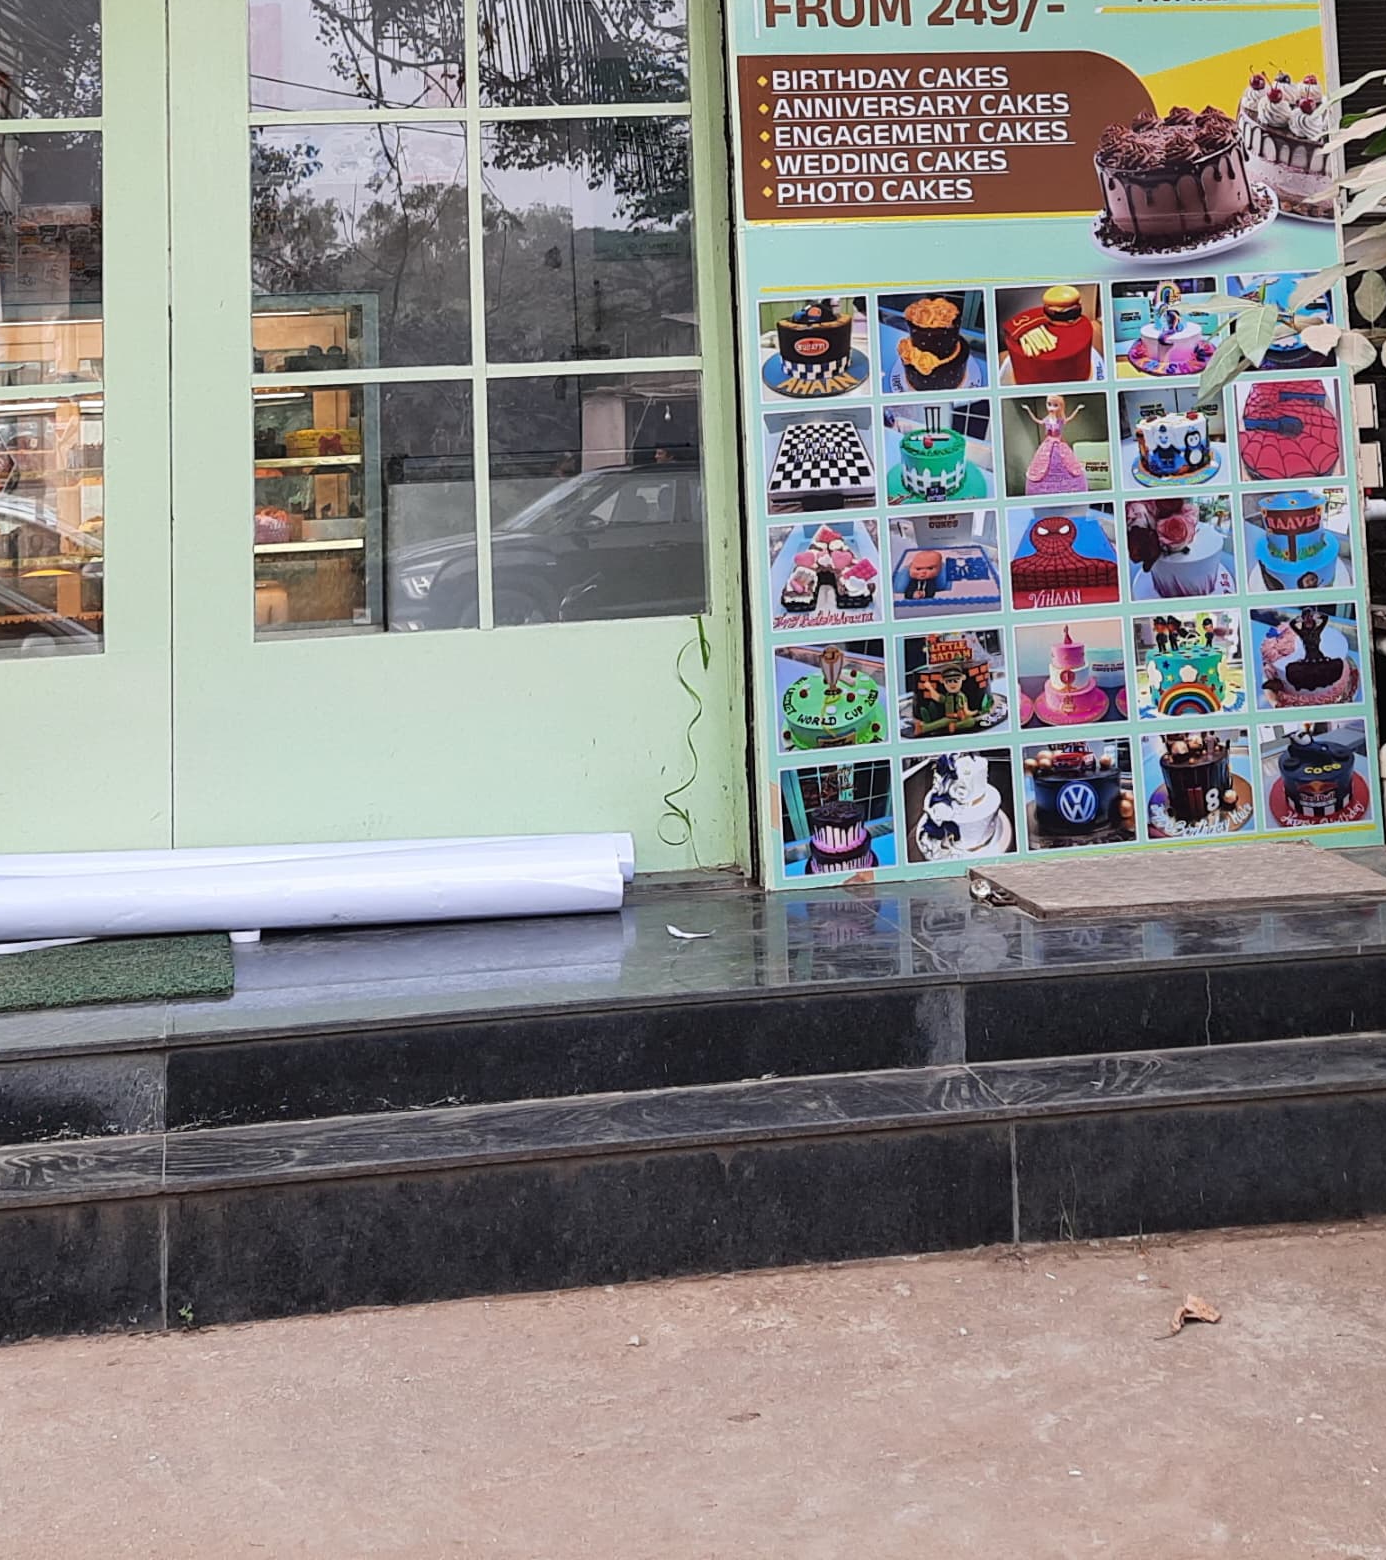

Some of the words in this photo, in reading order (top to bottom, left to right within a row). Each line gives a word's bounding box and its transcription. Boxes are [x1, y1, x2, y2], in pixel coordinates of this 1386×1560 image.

[773, 68, 912, 90] BIRTHDAY
[919, 67, 1010, 89] CAKES
[773, 96, 972, 119] ANNIVERSARY
[979, 94, 1070, 116] CAKES
[774, 124, 971, 147] ENGAGEMENT
[978, 121, 1069, 144] CAKES
[776, 153, 910, 176] WEDDING
[917, 150, 1008, 173] CAKES
[777, 182, 874, 204] PHOTO
[882, 179, 973, 202] CAKES
[777, 371, 860, 395] AHAAN
[1028, 589, 1081, 608] VIHAAN
[931, 641, 966, 652] LITTLE
[797, 713, 837, 726] WORLD
[844, 705, 863, 721] CUP
[1303, 762, 1342, 775] COCO
[1205, 787, 1220, 812] 8
